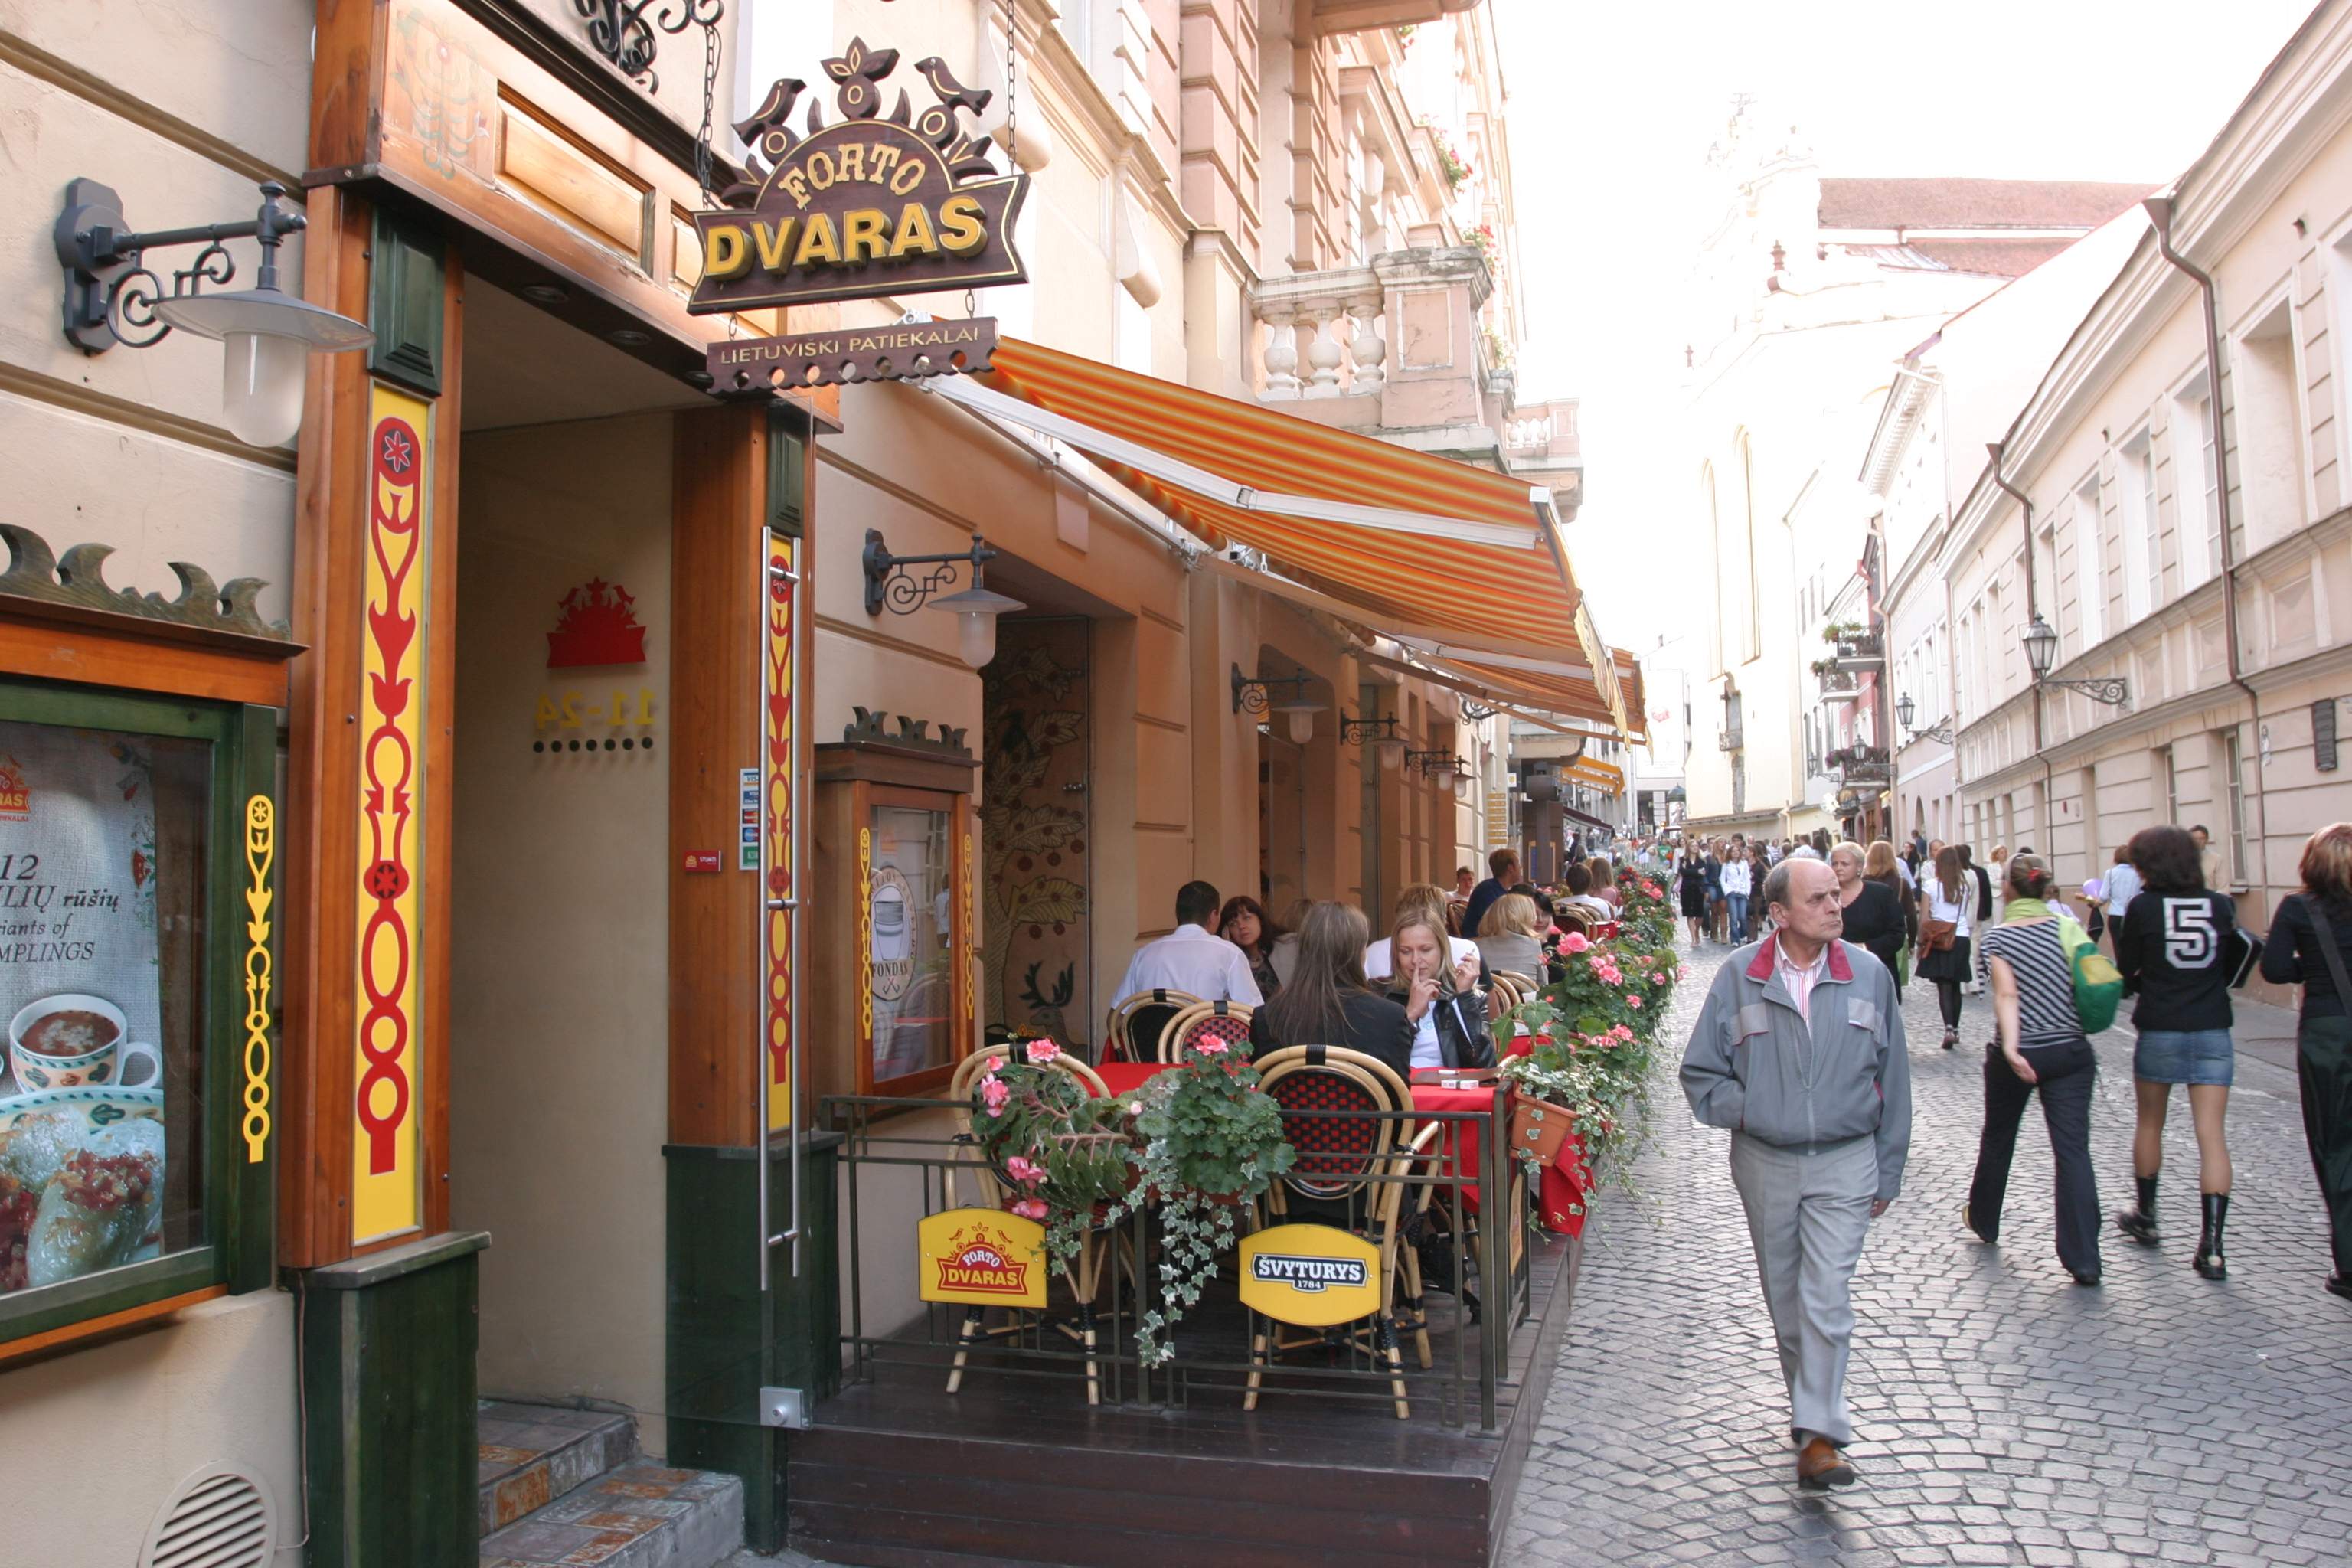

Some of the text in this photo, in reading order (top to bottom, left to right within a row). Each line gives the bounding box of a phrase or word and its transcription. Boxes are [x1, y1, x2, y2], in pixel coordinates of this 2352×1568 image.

[778, 143, 926, 209] FORTO
[704, 195, 987, 280] DVARAS
[720, 327, 978, 364] LIETUVIŠKI PATIEKALAI
[0, 854, 38, 880] 12
[63, 889, 119, 913] rūšių
[52, 913, 74, 939] of
[2163, 897, 2218, 969] 5
[962, 1250, 1000, 1267] FORTO
[1259, 1256, 1361, 1281] ŠVYTURYS
[948, 1269, 1018, 1286] DVARAS
[1298, 1280, 1321, 1289] 1784
